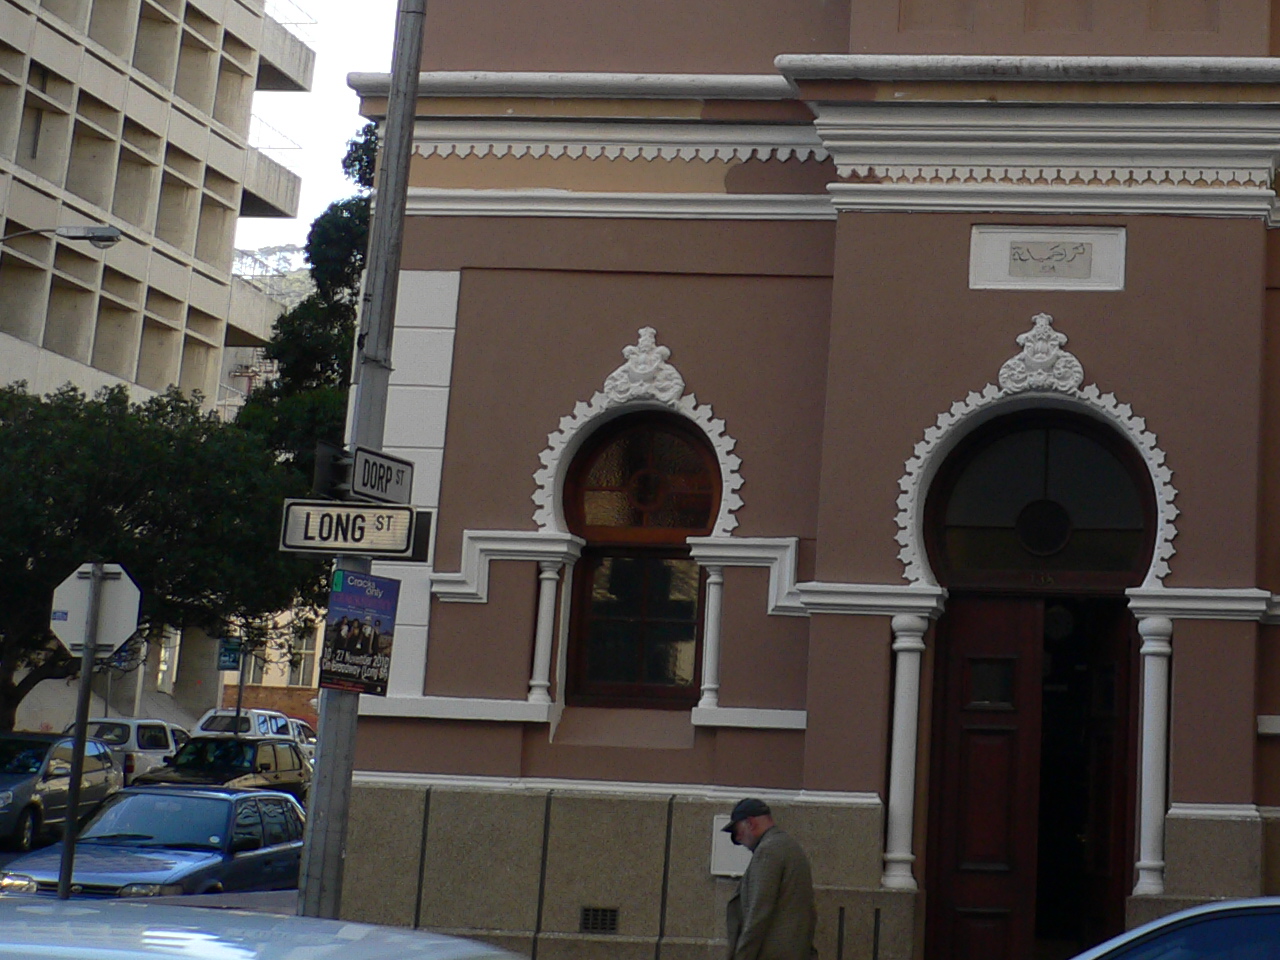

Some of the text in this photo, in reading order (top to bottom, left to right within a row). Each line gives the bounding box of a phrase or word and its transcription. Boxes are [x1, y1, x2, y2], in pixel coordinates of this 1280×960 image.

[362, 458, 405, 494] DORP ST
[303, 511, 394, 543] LONG ST
[365, 587, 384, 599] only
[336, 650, 345, 661] 27
[345, 651, 373, 665] November
[332, 660, 361, 677] Broadway
